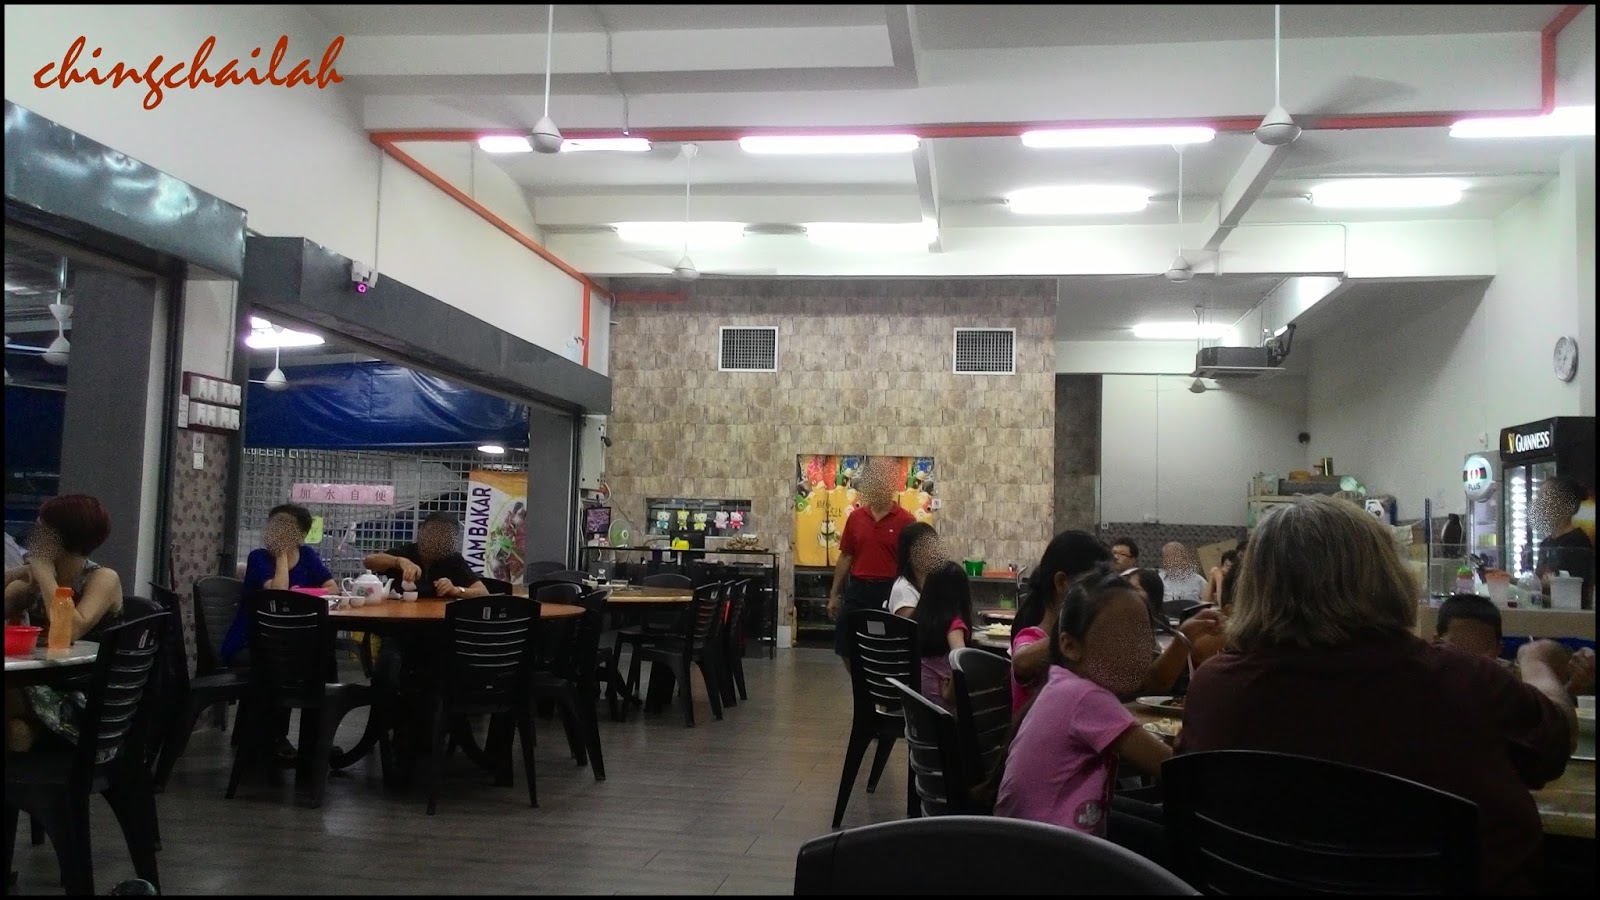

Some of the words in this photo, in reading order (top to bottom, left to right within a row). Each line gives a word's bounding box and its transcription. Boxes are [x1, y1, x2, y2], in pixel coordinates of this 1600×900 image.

[1515, 431, 1550, 452] GUINNESS
[301, 488, 387, 502] 加水自便
[468, 487, 492, 537] BAKAR
[465, 539, 487, 576] YAM
